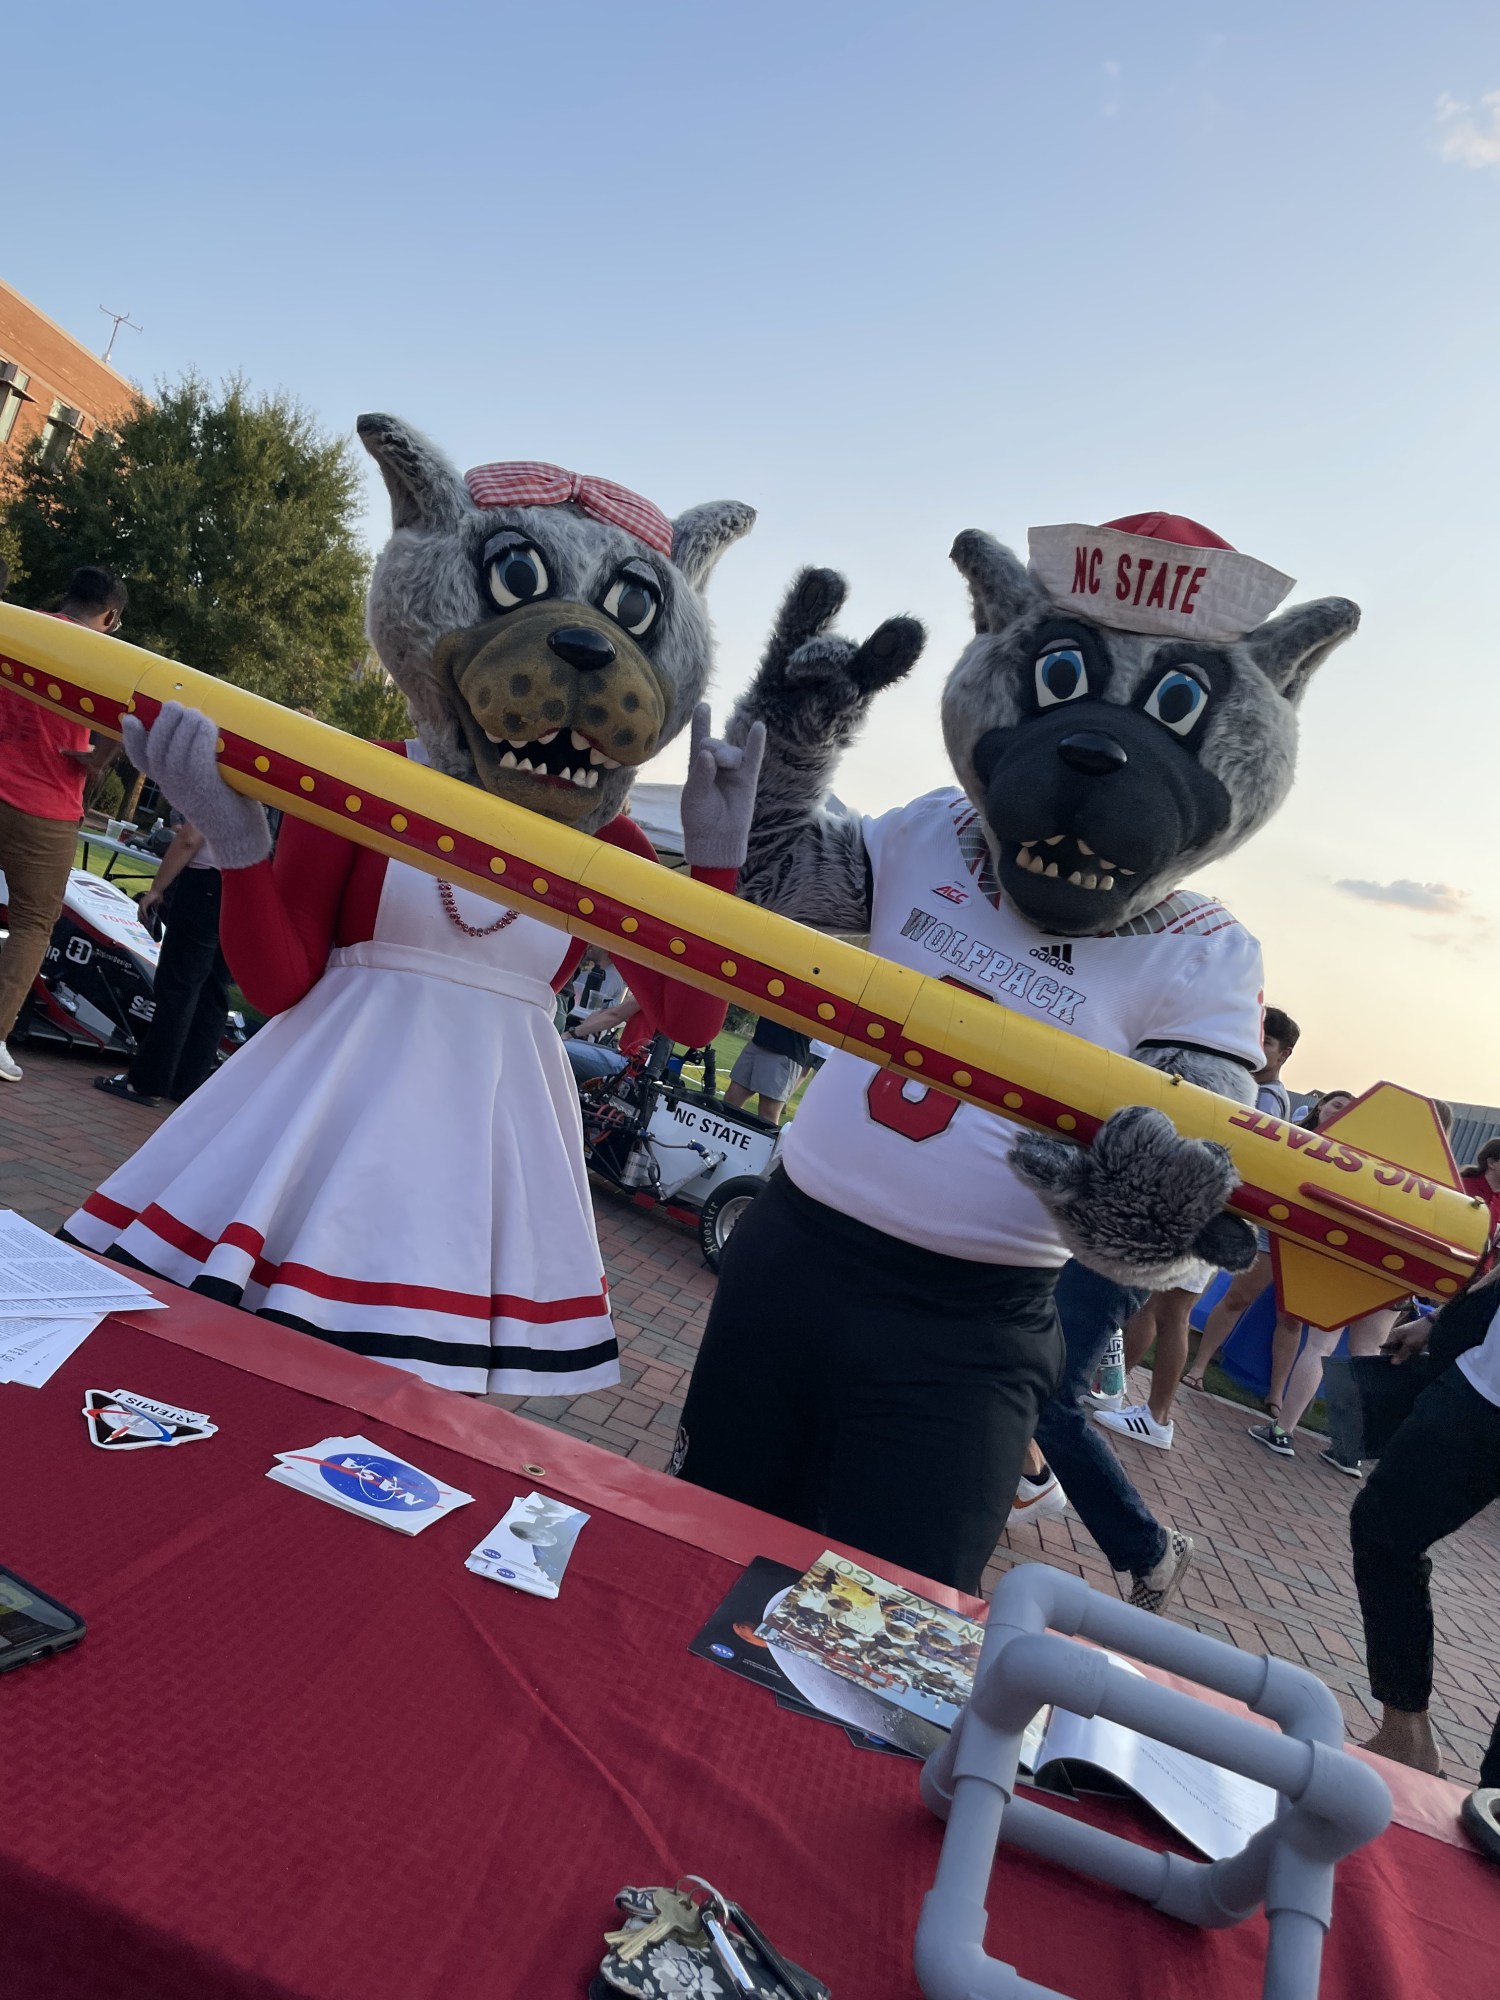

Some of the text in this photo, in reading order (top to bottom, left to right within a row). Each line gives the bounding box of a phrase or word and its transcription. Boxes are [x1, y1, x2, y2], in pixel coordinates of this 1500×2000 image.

[1072, 546, 1207, 614] NC STATE
[935, 886, 969, 902] ACC
[100, 913, 143, 929] TOSHI
[46, 945, 60, 962] IR
[899, 907, 1087, 1025] WOLFPACK
[1028, 947, 1075, 976] adidas
[131, 995, 157, 1020] SAE
[673, 1108, 752, 1151] NC STATE
[1229, 1110, 1437, 1201] NC STATE
[703, 1201, 719, 1256] Hoosier
[126, 1397, 200, 1424] ARTEMIS
[342, 1458, 424, 1506] NASA
[835, 1561, 874, 1586] GO
